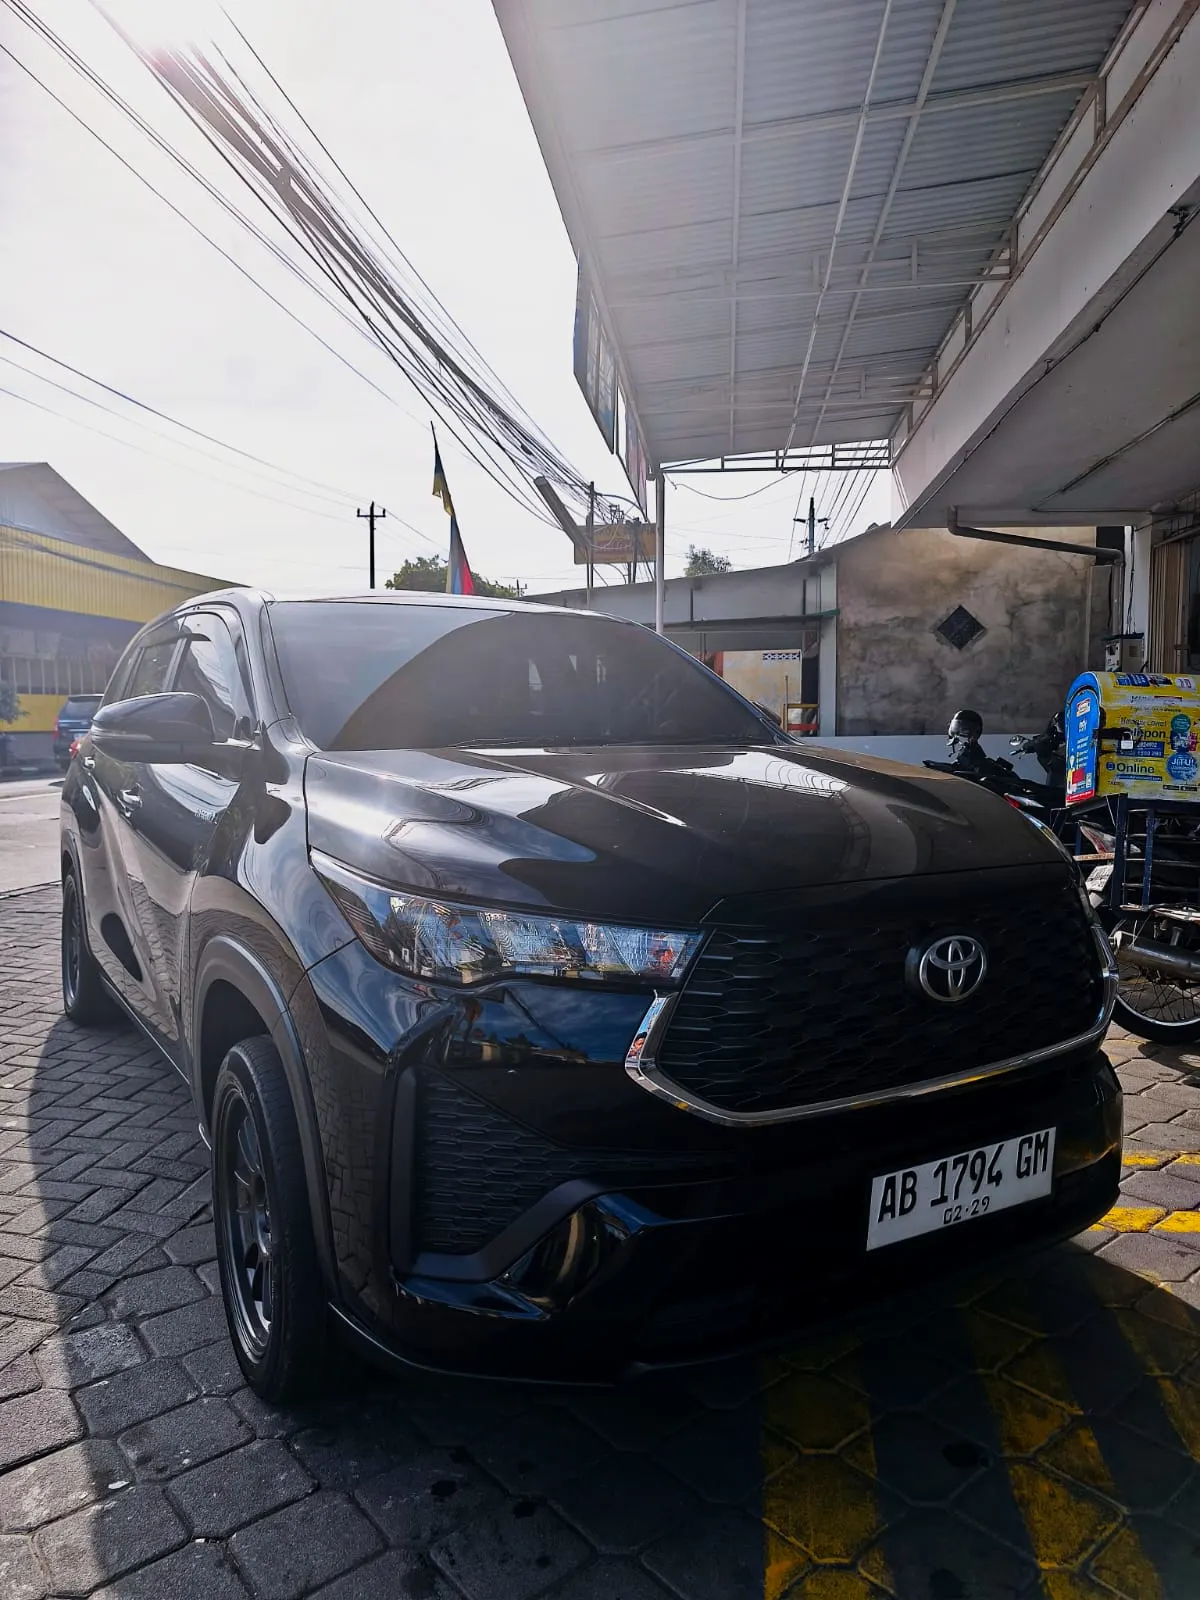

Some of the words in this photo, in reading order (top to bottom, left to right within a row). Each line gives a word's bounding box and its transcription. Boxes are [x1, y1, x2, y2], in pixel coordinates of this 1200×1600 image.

[1116, 762, 1155, 774] Online
[878, 1170, 917, 1223] AB
[930, 1144, 1005, 1208] 1794
[1016, 1131, 1050, 1180] GM
